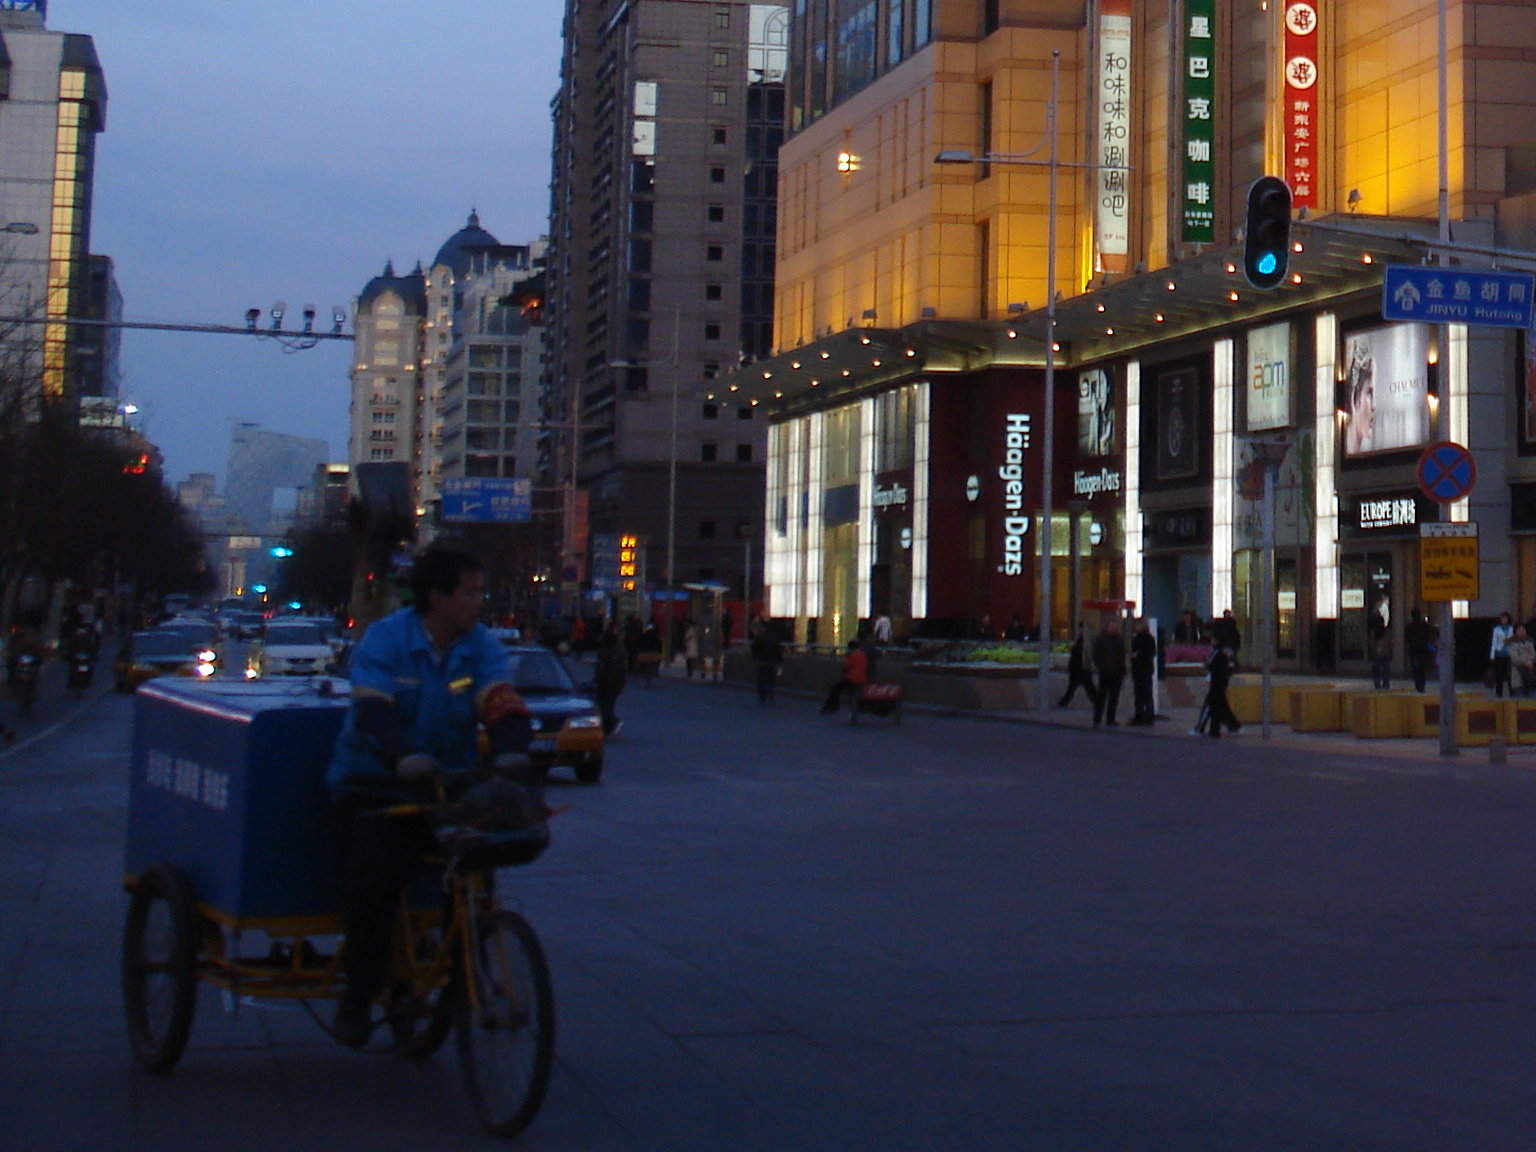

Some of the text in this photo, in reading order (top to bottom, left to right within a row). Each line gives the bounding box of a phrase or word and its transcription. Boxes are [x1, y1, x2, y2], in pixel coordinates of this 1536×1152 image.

[1188, 16, 1211, 205] 星巴克咖啡
[1427, 278, 1526, 302] 金鱼胡同
[1427, 304, 1522, 322] JINYU Hutong
[1253, 360, 1285, 400] apm
[1360, 500, 1392, 520] EUROPE
